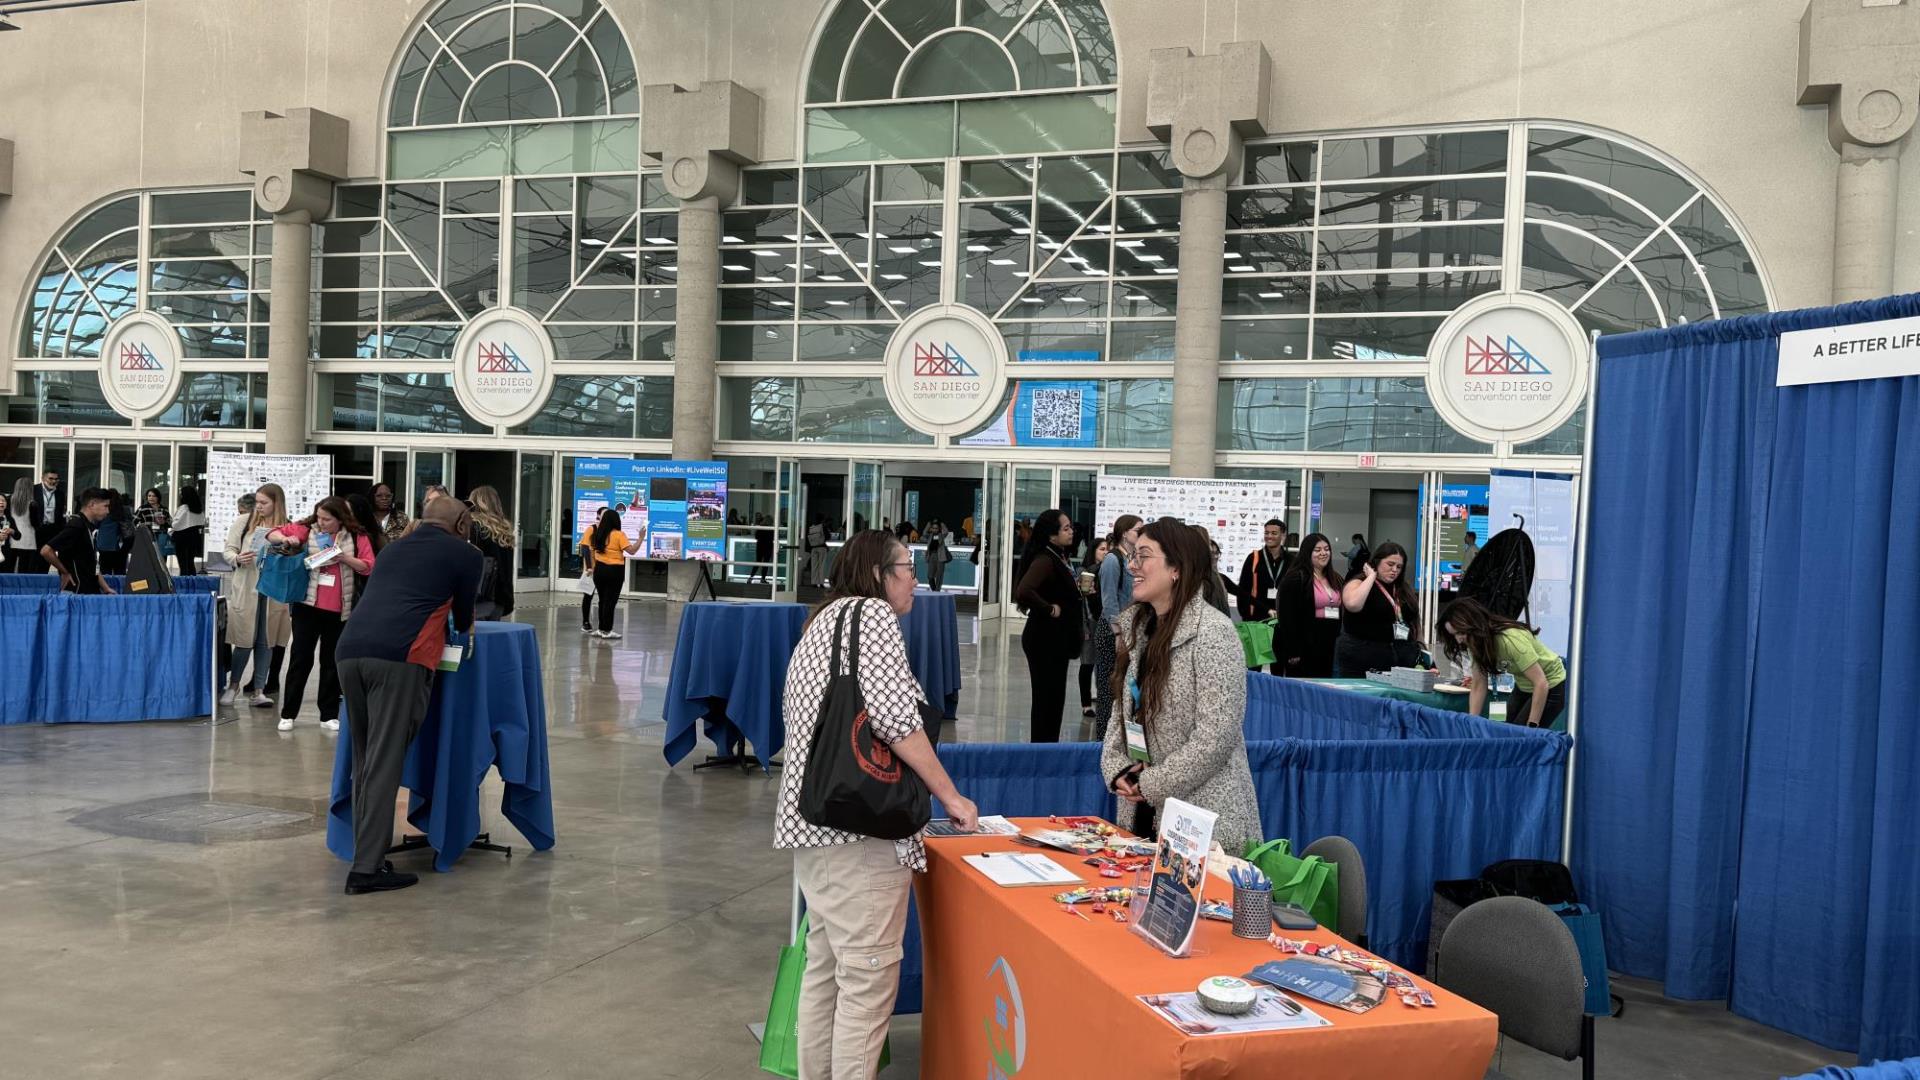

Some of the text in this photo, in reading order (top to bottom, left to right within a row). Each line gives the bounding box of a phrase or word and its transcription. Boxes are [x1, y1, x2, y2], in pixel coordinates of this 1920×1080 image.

[1813, 344, 1824, 357] A
[1828, 337, 1887, 356] BETTER
[138, 374, 165, 383] DIEGO
[477, 377, 533, 386] SAN DIEGO
[913, 381, 980, 391] SAN DIEGO
[1464, 381, 1553, 392] SAN DIEGO
[955, 392, 979, 400] center
[1463, 393, 1552, 401] convention center
[1360, 455, 1375, 467] EXIT
[632, 464, 646, 472] Post
[656, 465, 685, 474] LinkedIn:
